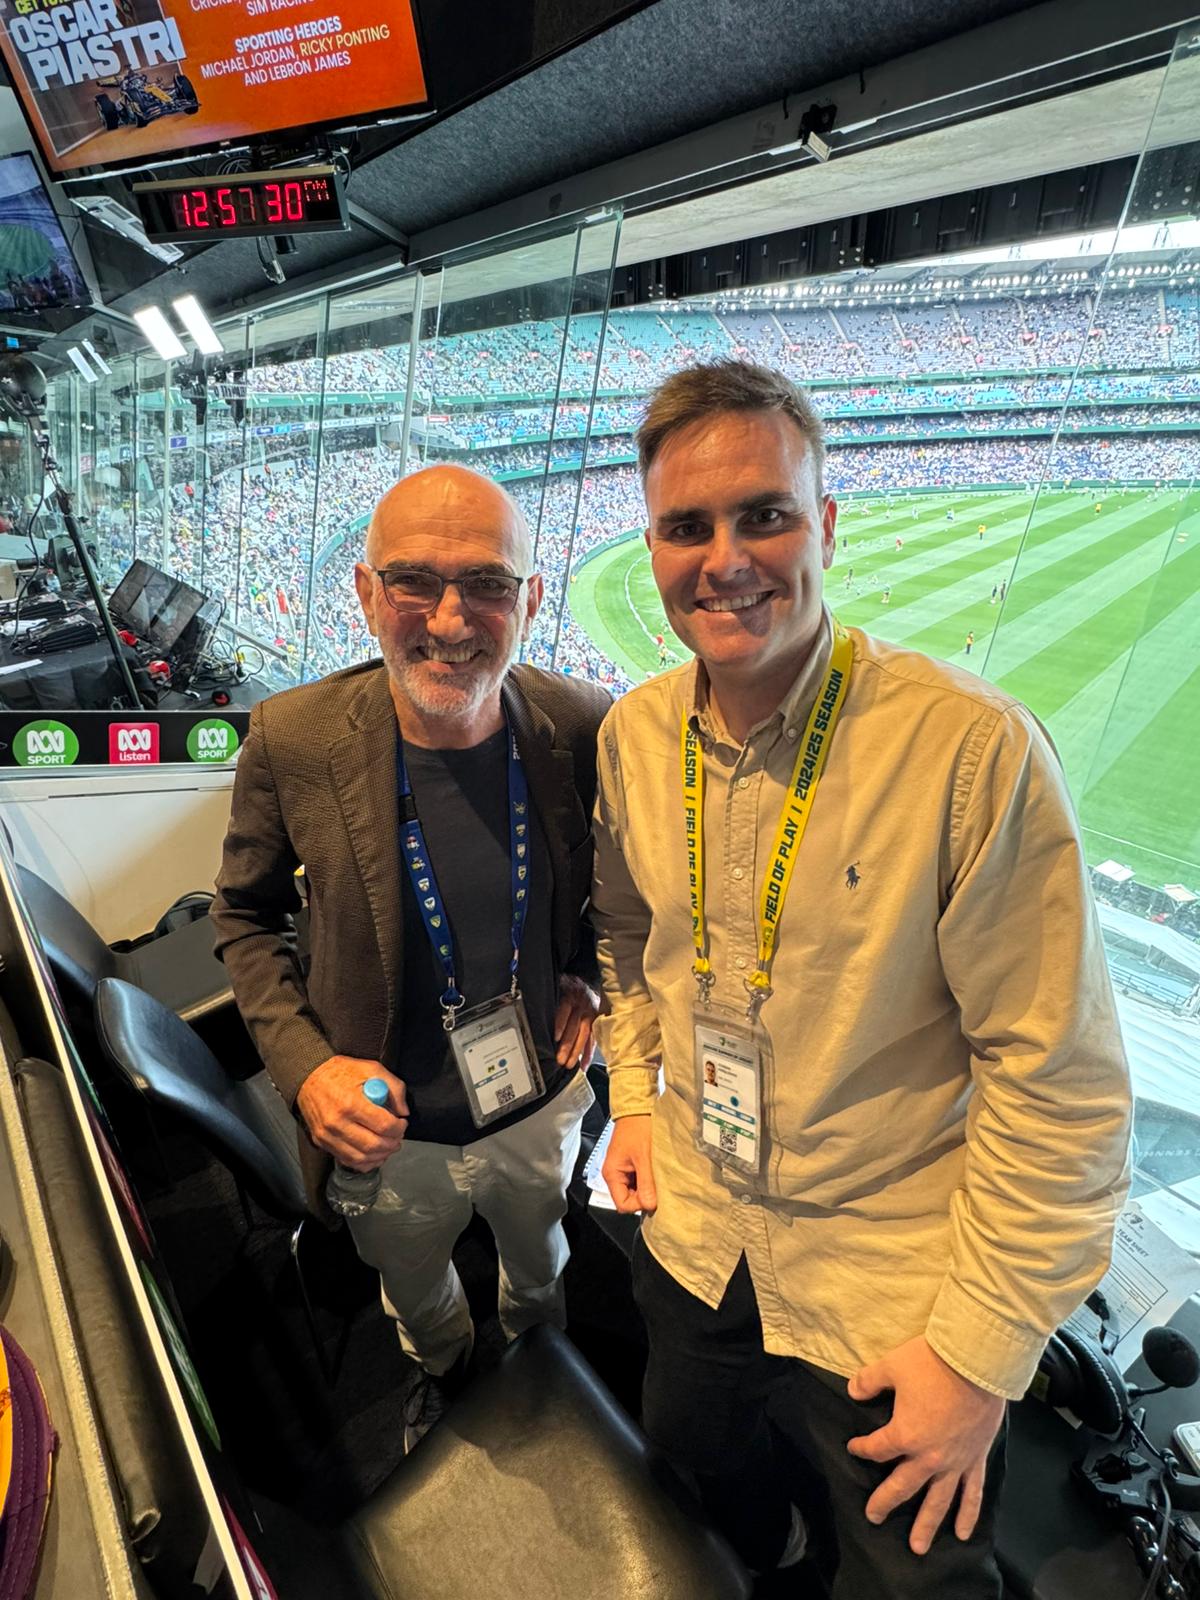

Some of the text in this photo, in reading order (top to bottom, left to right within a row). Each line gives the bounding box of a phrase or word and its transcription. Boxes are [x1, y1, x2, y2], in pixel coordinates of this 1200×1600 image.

[9, 0, 123, 53] OSCAR
[246, 0, 314, 16] SIM RAC
[27, 17, 187, 91] PIASTRI
[201, 24, 390, 79] MICHAEL JORDAN, RICKY PONTING
[234, 16, 342, 53] SPORTING HEROES
[243, 50, 351, 86] AND LEBRON JAMES
[814, 668, 844, 732] SEASON
[27, 754, 67, 765] SPORT
[119, 751, 151, 762] Listen
[197, 749, 229, 759] SPORT
[794, 732, 824, 801] 2024/25
[778, 817, 799, 859] PLAY
[771, 859, 787, 882] OF
[765, 881, 781, 924] FIELD
